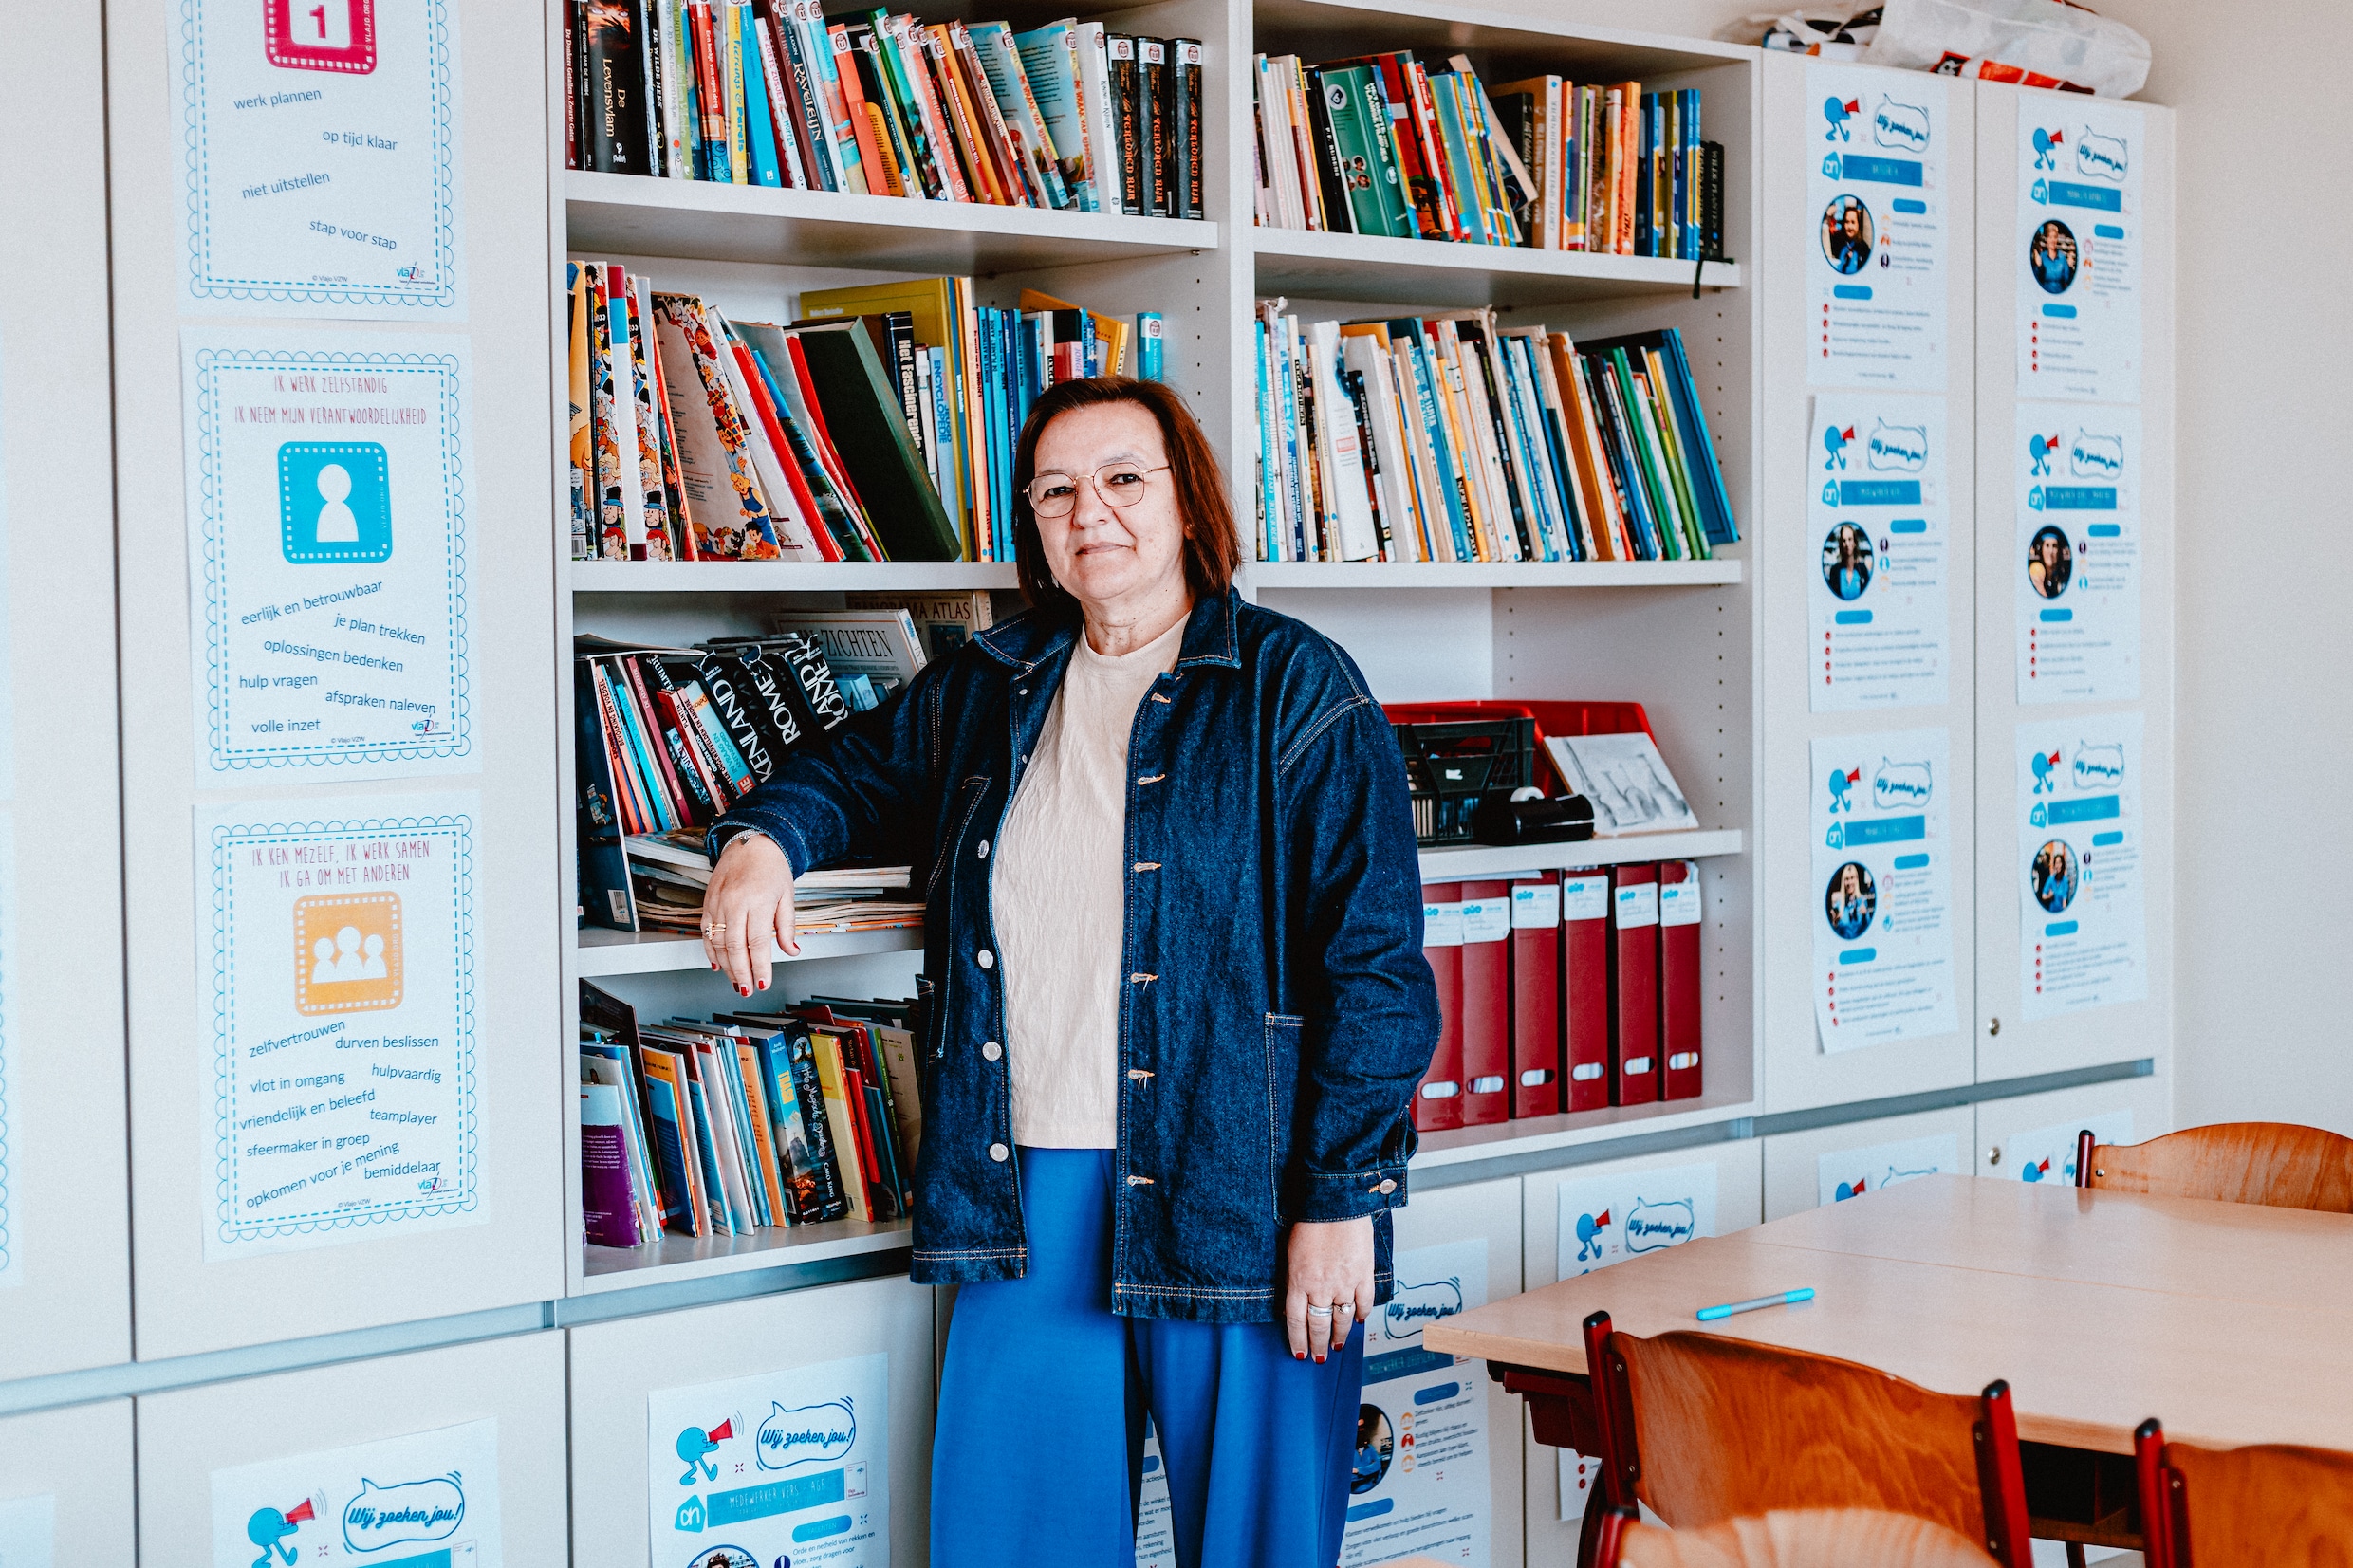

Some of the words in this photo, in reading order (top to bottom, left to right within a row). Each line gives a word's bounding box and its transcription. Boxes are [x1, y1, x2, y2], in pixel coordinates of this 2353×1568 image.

[310, 5, 326, 38] 1
[565, 29, 573, 39] De
[652, 28, 659, 44] DE
[777, 25, 792, 66] RUBENS
[789, 35, 799, 56] LOON
[668, 41, 676, 60] zoek
[733, 39, 743, 89] Piercings
[765, 43, 775, 68] ZOETE
[771, 71, 784, 102] ZUSJES
[655, 82, 663, 109] HEKS
[710, 76, 718, 93] eigen
[1101, 80, 1109, 99] KONING
[233, 94, 268, 110] werk
[270, 89, 322, 107] plannen
[602, 58, 616, 137] Levensvlam
[618, 88, 626, 108] De
[712, 93, 720, 109] deeg
[793, 62, 823, 141] RAVELEIJN
[1075, 91, 1084, 117] WRAAK
[784, 120, 794, 147] MOPPEN
[1364, 83, 1378, 123] VLAAMSE
[1371, 124, 1388, 162] FILMPJES
[323, 131, 339, 145] op
[343, 132, 362, 147] tijd
[367, 134, 398, 150] klaar
[1123, 114, 1134, 174] VERLOREN
[1153, 117, 1163, 175] VERLOREN
[1190, 119, 1199, 177] VERLOREN
[1328, 144, 1340, 177] RUBENS
[242, 183, 269, 199] niet
[270, 172, 330, 194] uitstellen
[309, 220, 336, 236] stap
[340, 227, 369, 243] voor
[371, 234, 397, 250] stap
[899, 340, 912, 362] Het
[275, 375, 285, 392] IK
[290, 375, 317, 393] WERK
[322, 376, 388, 394] ZELFSTANDIG
[934, 360, 947, 444] ENCYCLOPEDIE
[235, 406, 245, 423] IK
[250, 406, 276, 423] NEEM
[282, 407, 305, 423] MIJN
[310, 407, 427, 425] VERANTWOORDELIJKHEID
[1262, 391, 1275, 494] ONTDEKKINGSREIZIGERS
[1268, 500, 1279, 545] BEROEMDE
[241, 604, 282, 625] eerlijk
[284, 601, 301, 615] en
[304, 581, 382, 610] betrouwbaar
[933, 601, 971, 620] ATLAS
[334, 613, 347, 628] je
[350, 617, 376, 634] plan
[380, 623, 426, 645] trekken
[264, 639, 340, 662] oplossingen
[344, 650, 404, 673] bedenken
[239, 675, 269, 690] hulp
[272, 674, 318, 689] vragen
[599, 679, 612, 705] VOEDSEL
[633, 668, 646, 699] ATMOSFEER
[325, 690, 386, 709] afspraken
[389, 698, 436, 714] naleven
[684, 699, 700, 719] ANDERE
[755, 673, 801, 745] ROME
[251, 719, 284, 733] volle
[287, 719, 321, 731] inzet
[676, 704, 690, 729] PLANTEN
[610, 713, 625, 747] BEVOLKING
[718, 743, 733, 766] VRAAG
[252, 848, 263, 866] IK
[269, 847, 288, 865] KEN
[295, 846, 339, 864] MEZELF,
[346, 844, 356, 861] IK
[363, 841, 390, 860] WERK
[396, 840, 430, 858] SAMEN
[280, 870, 290, 888] IK
[297, 870, 310, 887] GA
[318, 868, 332, 886] OM
[338, 867, 357, 884] MET
[363, 863, 410, 883] ANDEREN
[250, 1021, 345, 1058] zelfvertrouwen
[336, 1036, 379, 1049] durven
[383, 1035, 439, 1048] beslissen
[250, 1079, 276, 1093] vlot
[280, 1078, 291, 1090] in
[295, 1072, 345, 1087] omgang
[372, 1063, 442, 1084] hulpvaardig
[777, 1069, 795, 1104] TRASH
[239, 1105, 306, 1130] vriendelijk
[310, 1103, 326, 1115] en
[329, 1089, 376, 1111] beleefd
[370, 1108, 438, 1126] teamplayer
[246, 1140, 318, 1157] sfeermaker
[322, 1137, 332, 1149] in
[336, 1134, 370, 1150] groep
[246, 1178, 307, 1208] opkomen
[310, 1169, 338, 1185] voor
[341, 1159, 353, 1176] je
[356, 1141, 399, 1166] mening
[364, 1162, 441, 1179] bemiddelaar
[823, 1162, 832, 1179] CARO
[826, 1180, 836, 1197] KING
[1629, 1219, 1643, 1236] Wij
[1643, 1221, 1673, 1236] zoeken
[1388, 1301, 1405, 1321] Wij
[1404, 1303, 1436, 1321] zoeken
[761, 1429, 784, 1449] Wij
[783, 1428, 826, 1449] zoeken
[823, 1427, 854, 1448] jou!
[730, 1487, 778, 1509] MEDEWERKER
[782, 1484, 799, 1499] VERS
[348, 1506, 376, 1530] Wij
[375, 1505, 429, 1529] zoeken
[426, 1503, 463, 1529] jou!
[792, 1546, 808, 1556] Orde
[817, 1540, 838, 1551] netheid
[848, 1533, 867, 1543] rekken
[823, 1548, 842, 1561] dragen
